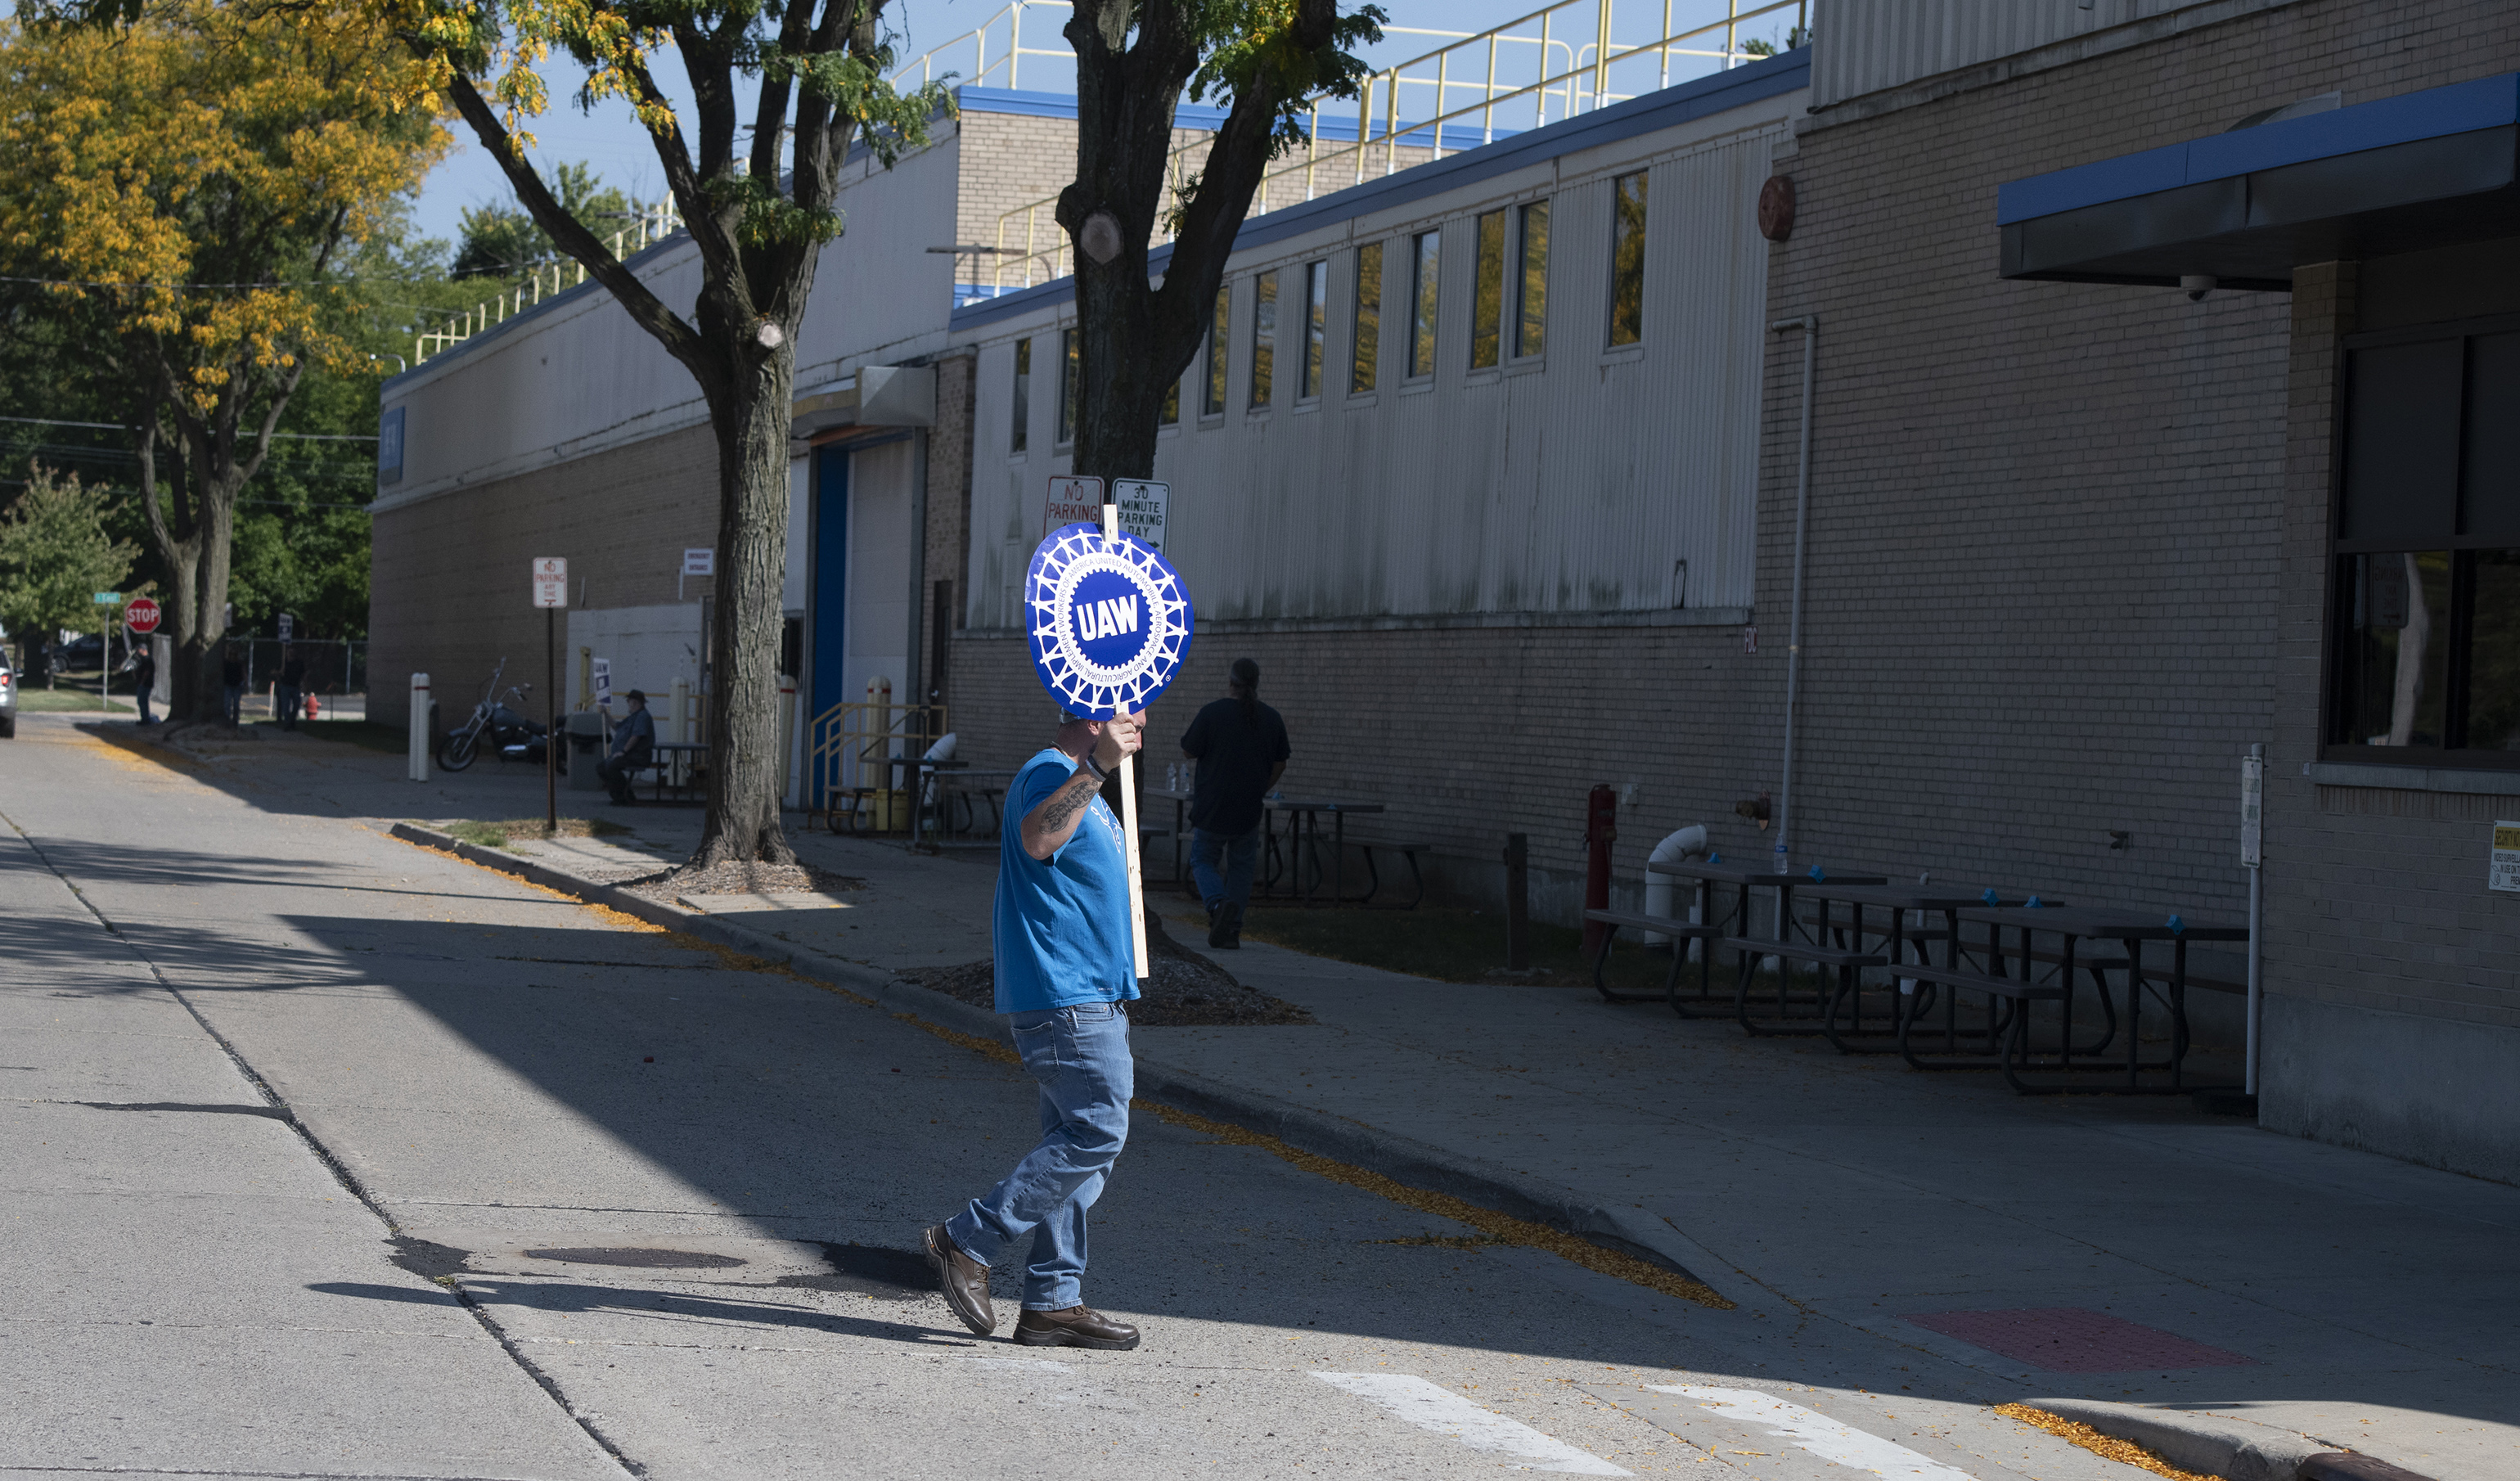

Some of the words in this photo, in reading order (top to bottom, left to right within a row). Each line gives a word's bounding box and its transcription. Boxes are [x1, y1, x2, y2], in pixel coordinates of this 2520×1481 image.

[1064, 484, 1083, 502] NO
[1134, 488, 1149, 499] 30
[1048, 502, 1098, 522] PARKING
[1122, 499, 1160, 513] MINUTE
[1118, 511, 1163, 526] PARKING
[1128, 525, 1150, 538] DAY
[544, 563, 556, 573] NO
[1069, 558, 1095, 578] AMERICA
[1096, 557, 1122, 567] UNITED
[536, 574, 565, 583] PARKING
[1062, 577, 1071, 588] OF
[1123, 564, 1159, 609] AUTOMOBILE,
[128, 608, 159, 623] STOP
[1058, 588, 1067, 628] WORKERS
[1076, 594, 1137, 641] UAW
[1146, 610, 1162, 657] AEROSPACE
[1744, 627, 1757, 654] FDC
[1060, 630, 1085, 672] IMPLEMENT
[1133, 655, 1147, 672] AND
[1084, 667, 1132, 682] AGRICULTURAL
[2495, 829, 2513, 846] SECURITY
[2494, 853, 2504, 862] VIDEO
[2500, 864, 2504, 873] IN
[2511, 865, 2517, 874] ON
